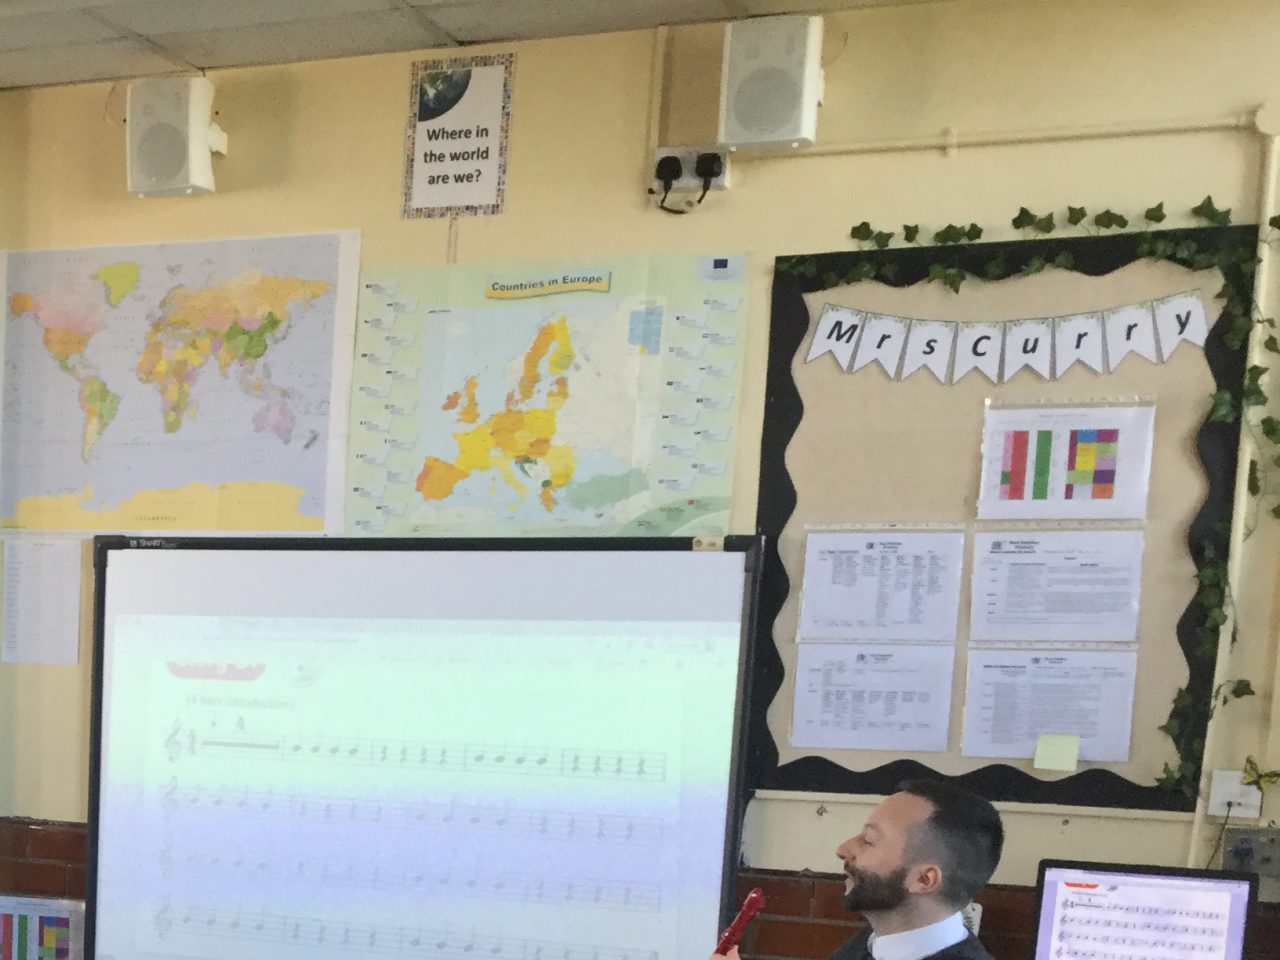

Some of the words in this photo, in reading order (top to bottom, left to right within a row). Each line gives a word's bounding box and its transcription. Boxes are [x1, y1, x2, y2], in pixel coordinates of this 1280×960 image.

[427, 126, 472, 141] Where
[476, 125, 489, 138] in
[424, 149, 446, 163] the
[450, 146, 489, 161] world
[427, 174, 450, 185] are
[454, 169, 482, 183] we?
[491, 281, 544, 292] Countries
[548, 278, 558, 286] in
[562, 275, 602, 285] Europe
